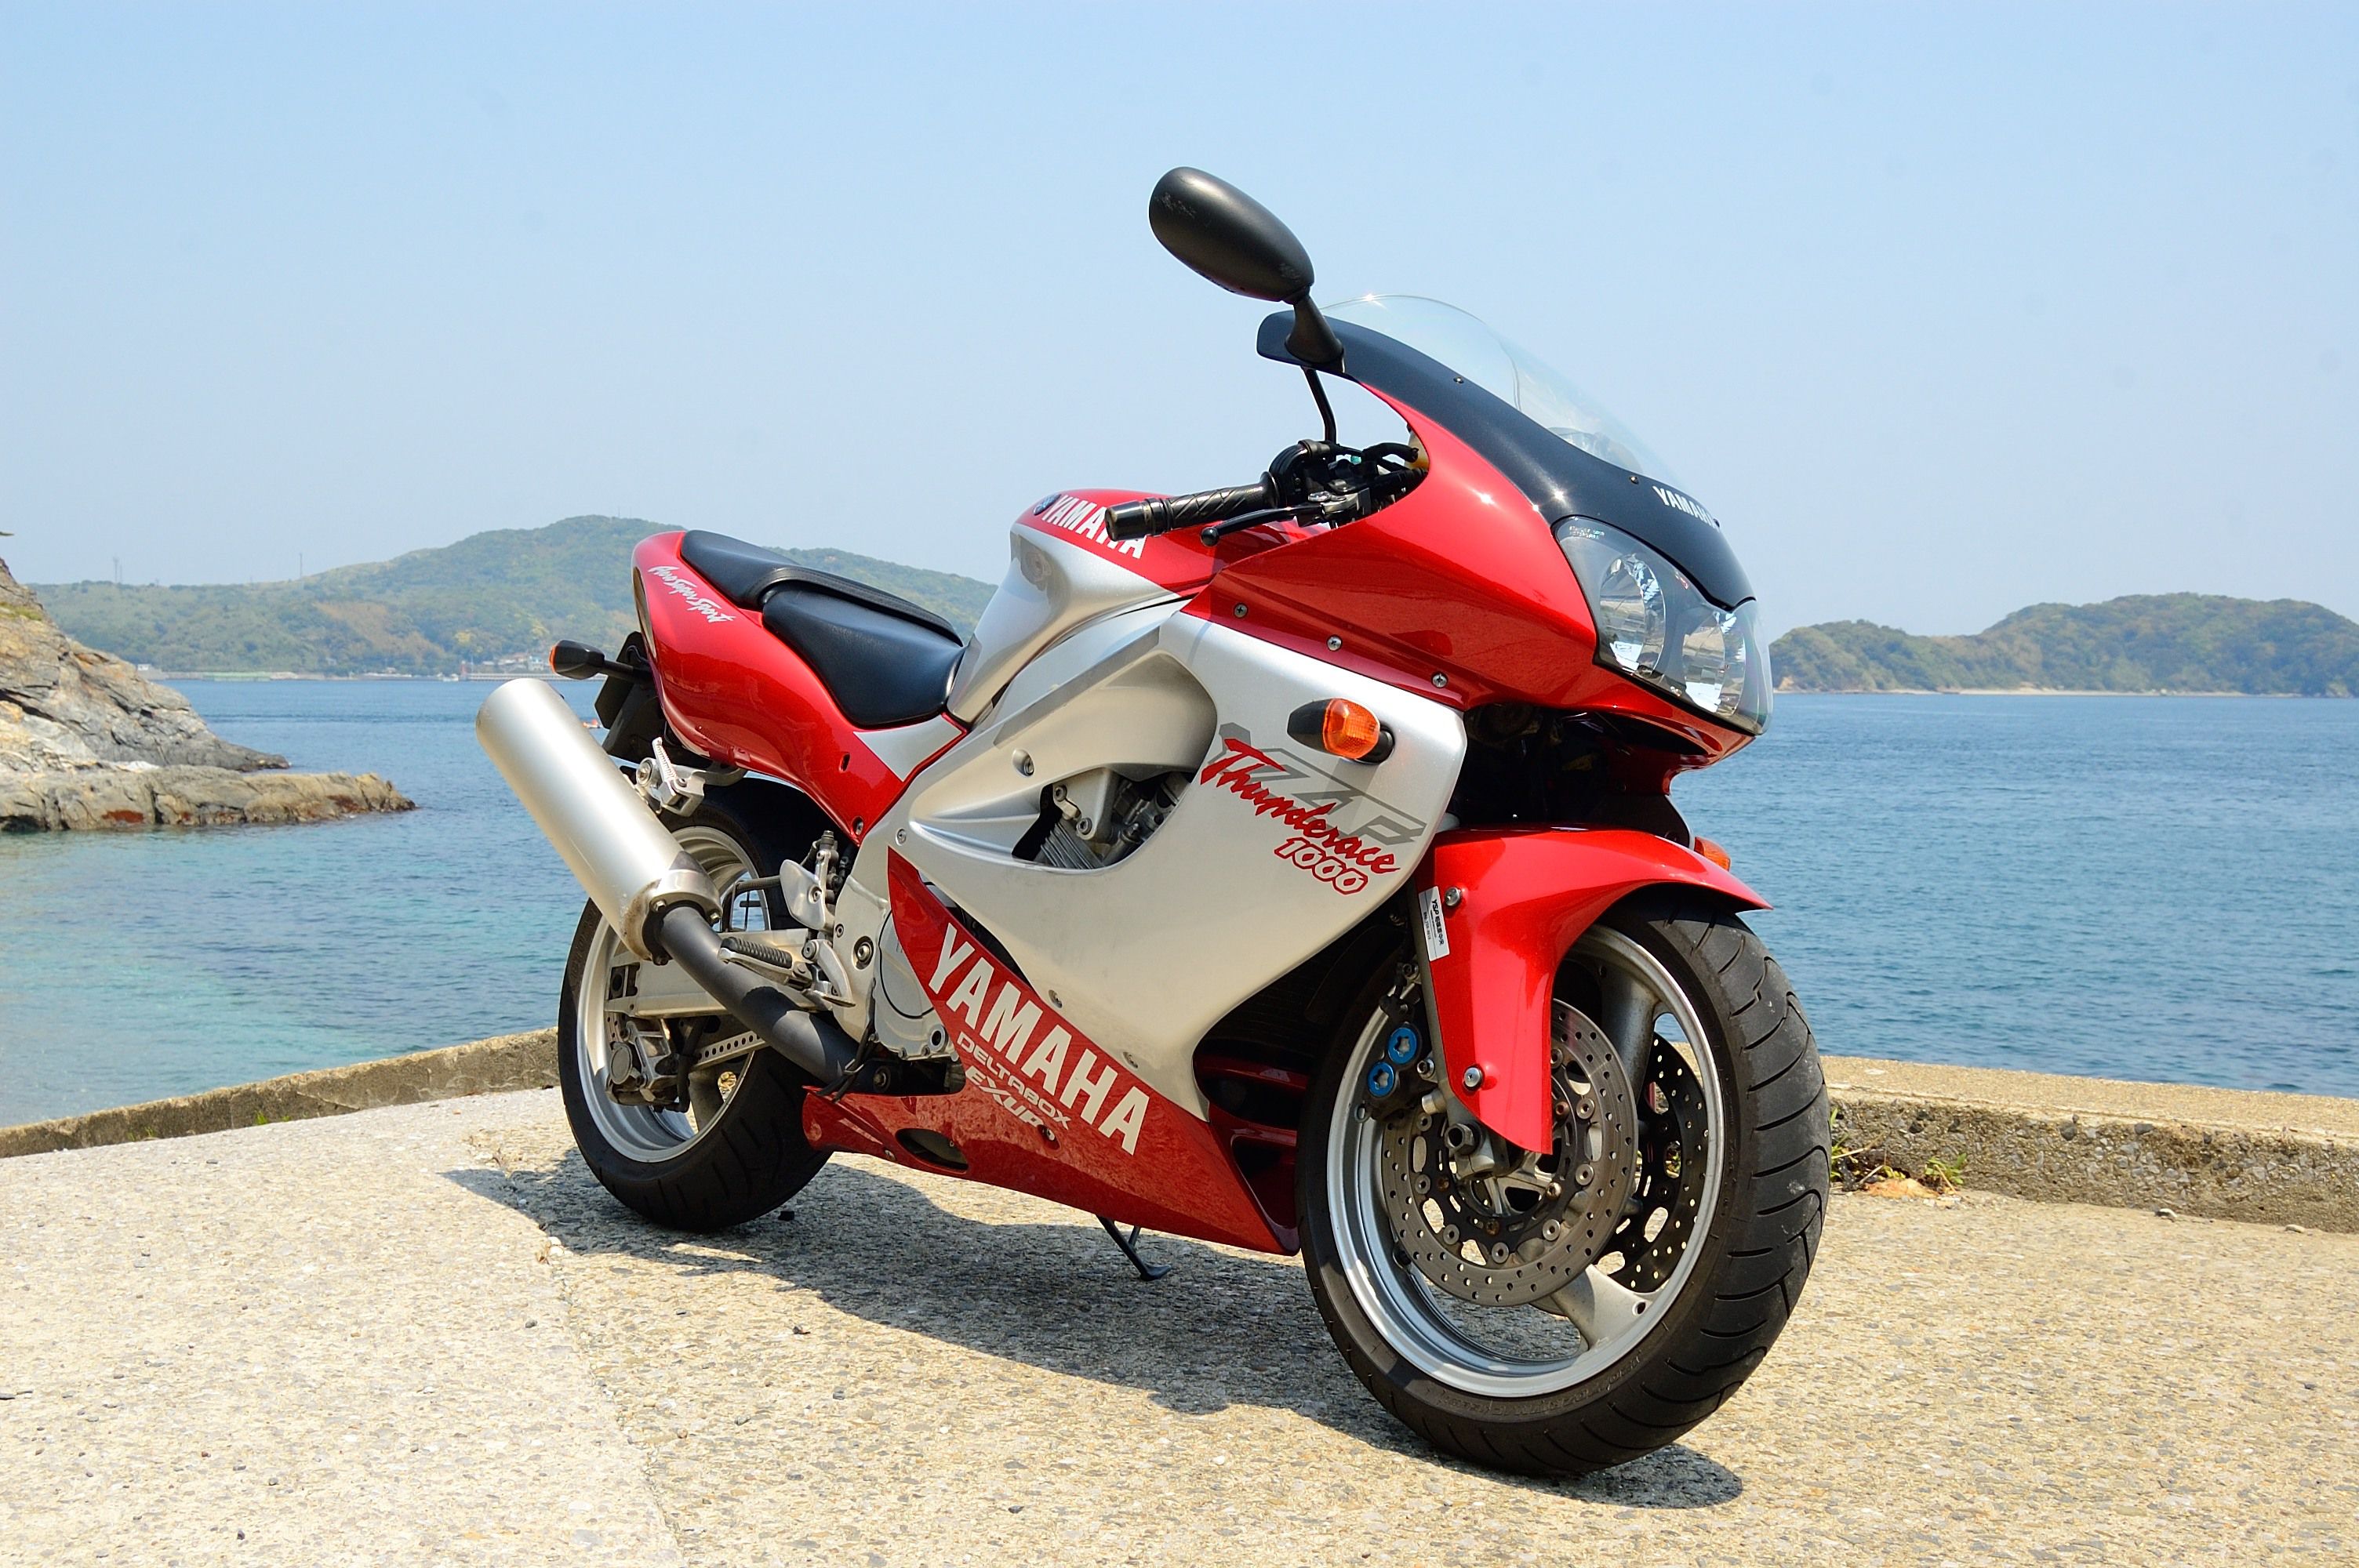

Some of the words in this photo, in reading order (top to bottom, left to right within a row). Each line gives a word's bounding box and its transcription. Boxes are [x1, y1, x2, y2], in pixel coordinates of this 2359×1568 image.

[1201, 739, 1400, 873] Thunderace
[1274, 837, 1369, 895] 1000
[929, 923, 1150, 1156] YAMAHA
[957, 1031, 1072, 1131] DELTABOX
[965, 1065, 1045, 1127] EXUP
